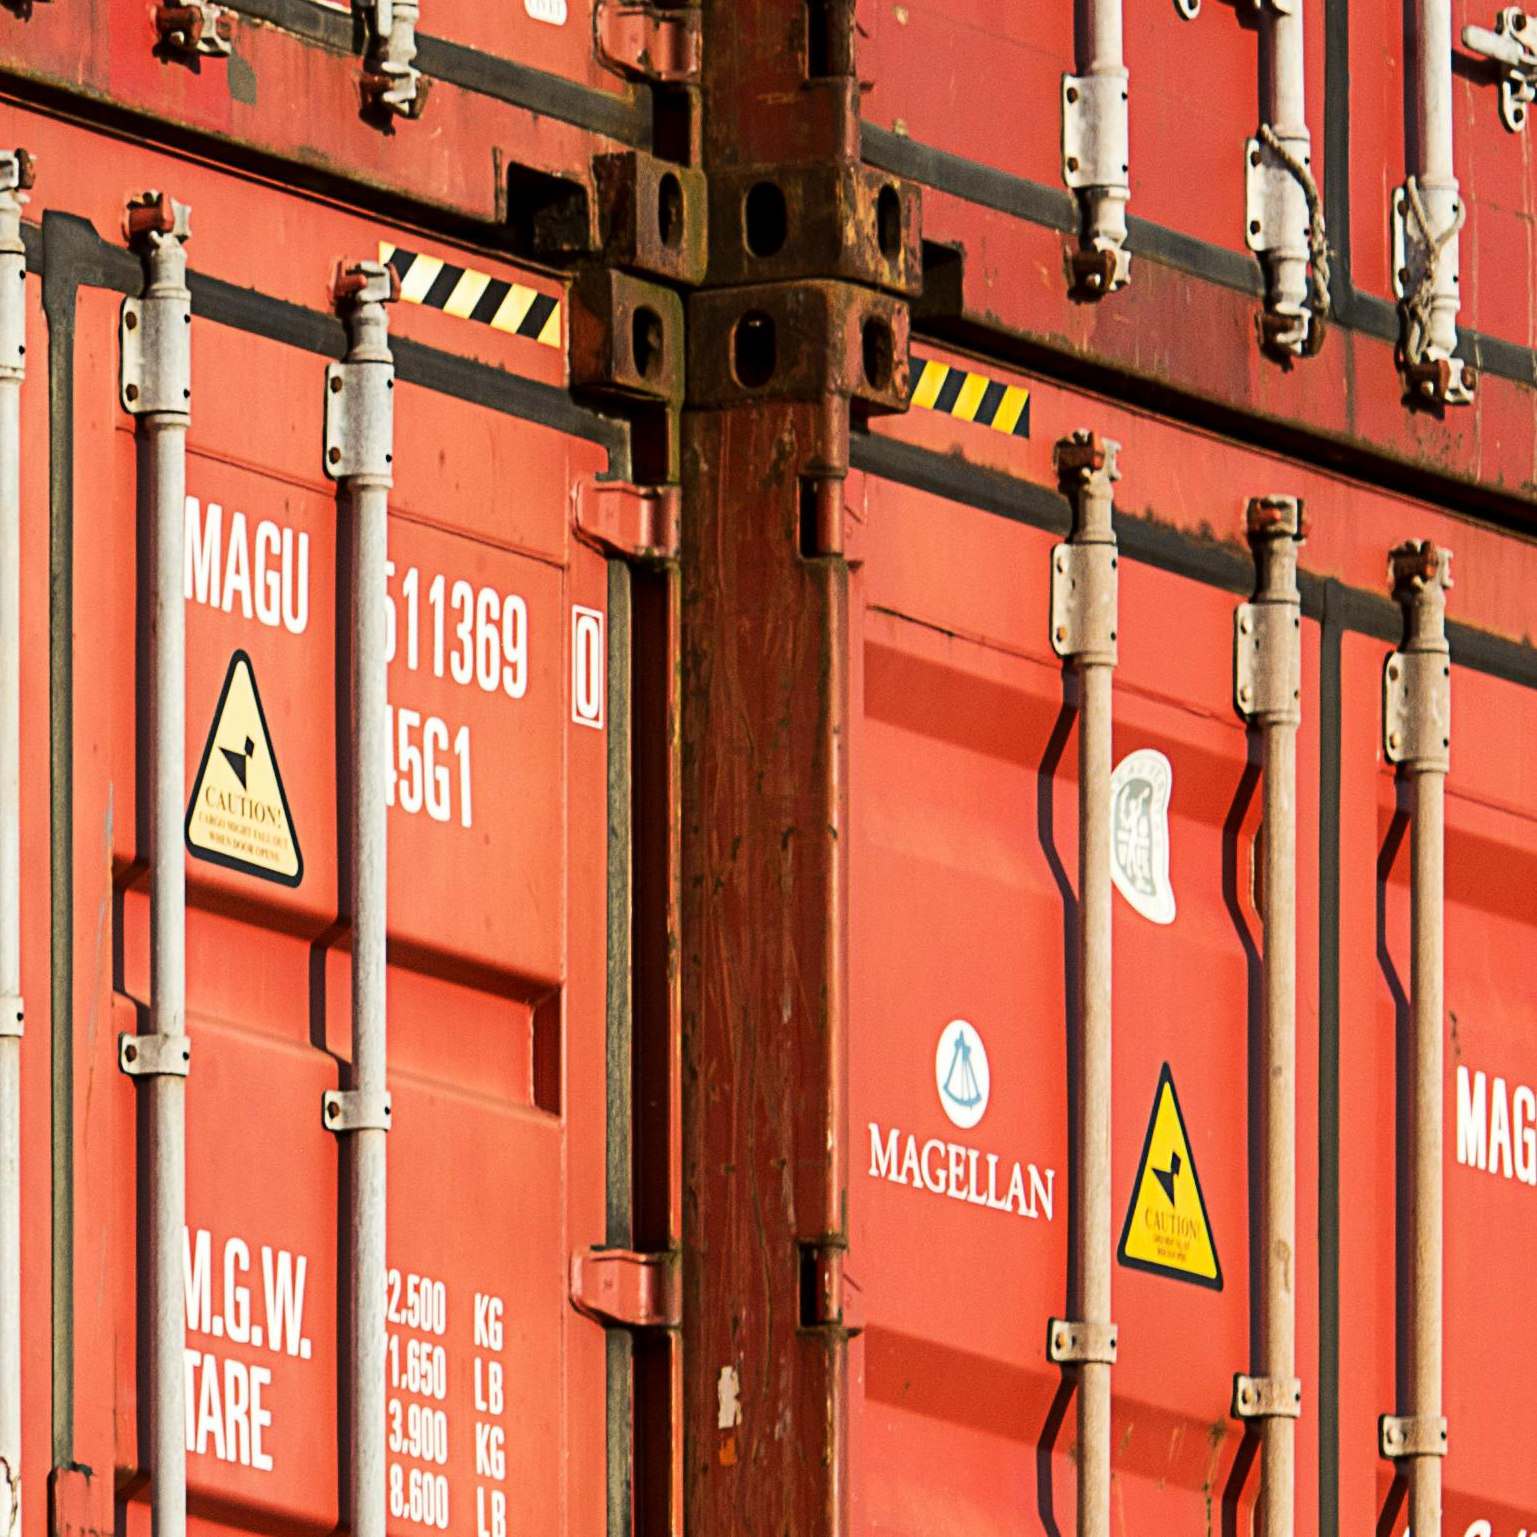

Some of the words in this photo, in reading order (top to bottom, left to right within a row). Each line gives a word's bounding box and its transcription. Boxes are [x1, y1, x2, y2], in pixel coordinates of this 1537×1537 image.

[184, 495, 309, 635] MAGU
[867, 1121, 1056, 1222] MAGELLAN
[183, 1225, 312, 1360] M.G.W.
[473, 1292, 504, 1351] KG
[183, 1347, 274, 1472] TARE
[473, 1357, 504, 1416] LB
[475, 1421, 507, 1482] KG
[476, 1486, 507, 1537] LB
